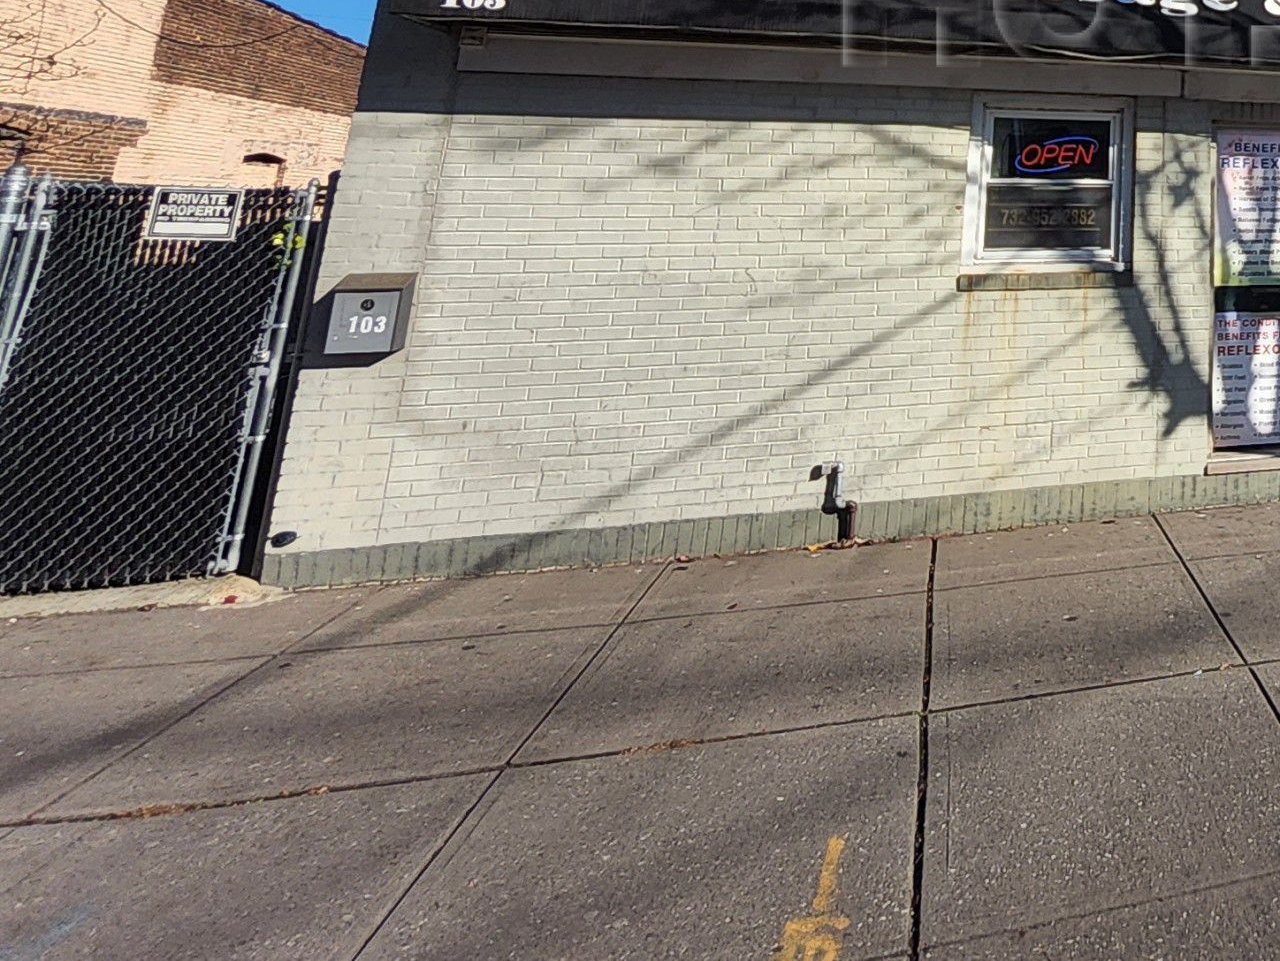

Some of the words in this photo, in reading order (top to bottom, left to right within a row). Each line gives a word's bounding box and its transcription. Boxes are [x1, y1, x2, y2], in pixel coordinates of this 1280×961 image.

[1021, 143, 1095, 166] OPEN
[168, 192, 229, 205] PRIVATE
[158, 204, 234, 217] PROPERTY
[348, 315, 387, 334] 103
[1216, 319, 1239, 329] THE
[1217, 331, 1269, 342] BENEFITS
